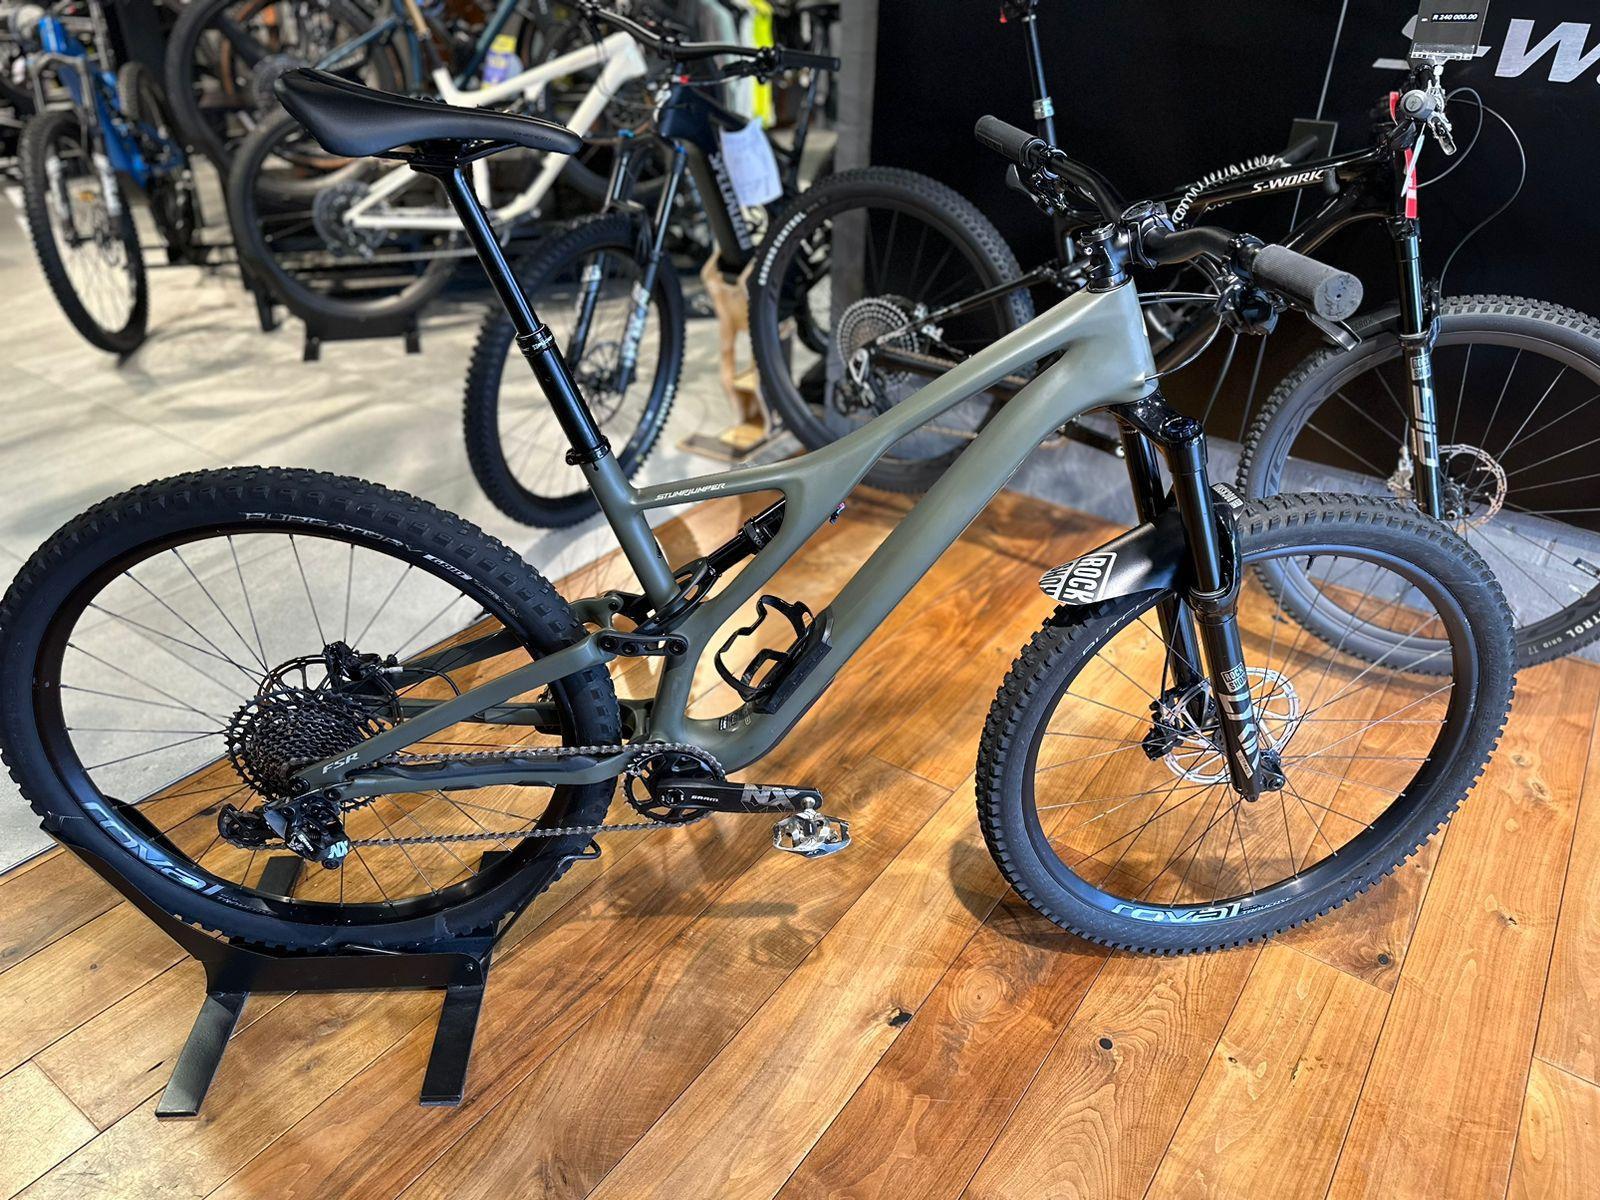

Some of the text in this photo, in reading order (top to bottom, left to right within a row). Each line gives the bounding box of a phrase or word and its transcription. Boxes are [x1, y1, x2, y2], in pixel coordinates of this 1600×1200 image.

[655, 482, 726, 500] STUMPJUMPER
[245, 512, 424, 553] PURGATORY
[1062, 557, 1108, 604] ROCK
[1223, 664, 1244, 683] ROCK
[322, 752, 360, 774] FSR
[1111, 902, 1242, 923] roval
